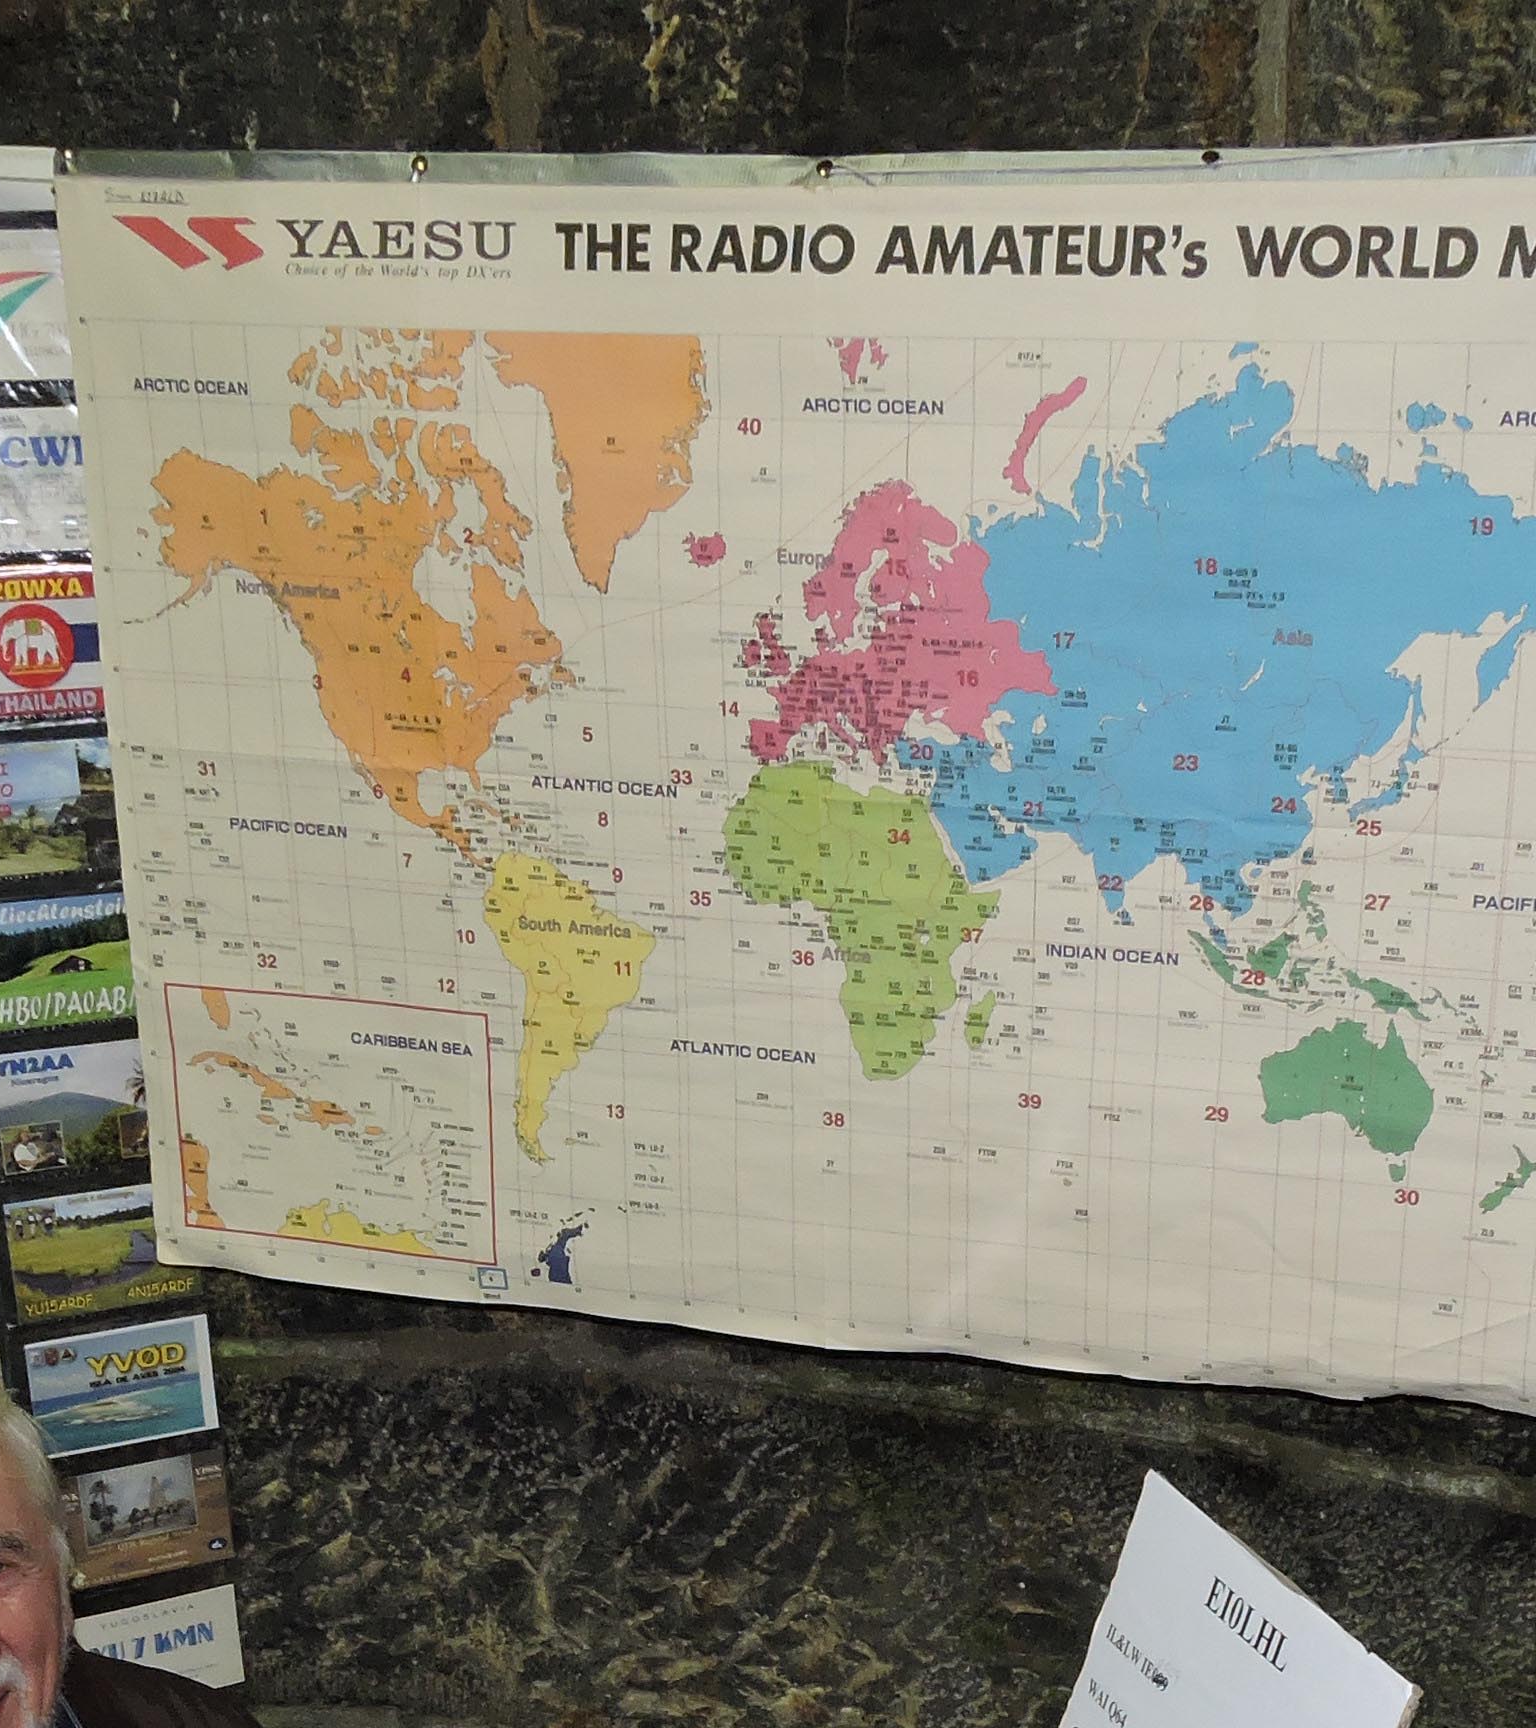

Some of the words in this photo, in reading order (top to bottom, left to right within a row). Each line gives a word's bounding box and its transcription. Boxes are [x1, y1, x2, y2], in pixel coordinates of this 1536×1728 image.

[276, 219, 517, 261] YAESU
[555, 221, 651, 274] THE
[670, 221, 856, 276] RADIO
[874, 224, 1208, 280] AMATEUR's
[1235, 224, 1479, 280] WORLD
[285, 263, 328, 277] Choice
[334, 263, 349, 278] of
[355, 263, 374, 277] the
[381, 263, 429, 277] World's
[438, 266, 459, 281] top
[133, 377, 191, 395] ARCTIC
[195, 378, 249, 397] OCEAN
[802, 397, 869, 416] ARCTIC
[874, 398, 944, 416] OCEAN
[738, 417, 761, 435] 40
[259, 508, 268, 525] 1
[1471, 518, 1493, 535] 19
[464, 528, 474, 545] 2
[777, 548, 834, 571] Europe
[884, 557, 906, 577] 15
[1194, 557, 1216, 575] 18
[235, 578, 276, 597] North
[277, 582, 340, 601] America
[1052, 632, 1076, 650] 17
[1272, 627, 1313, 647] Asia
[312, 674, 323, 691] 3
[400, 667, 412, 684] 4
[956, 669, 979, 687] 16
[720, 702, 739, 717] 14
[582, 727, 592, 743] 5
[911, 743, 933, 759] 20
[197, 761, 217, 778] 31
[1172, 755, 1197, 771] 23
[671, 769, 693, 786] 33
[372, 781, 383, 798] 6
[531, 776, 613, 793] ATLANTIC
[618, 781, 678, 799] OCEAN
[1022, 800, 1044, 817] 21
[1270, 796, 1296, 813] 24
[598, 811, 609, 828] 8
[1357, 819, 1382, 836] 25
[229, 818, 289, 834] PACIFIC
[294, 822, 348, 839] OCEAN
[887, 828, 911, 845] 34
[402, 853, 412, 869] 7
[612, 867, 624, 884] 9
[1098, 876, 1123, 892] 22
[689, 890, 712, 907] 35
[1189, 894, 1215, 912] 26
[1364, 894, 1389, 911] 27
[0, 897, 126, 925] Liechtenstei
[518, 916, 564, 934] South
[568, 921, 632, 939] America
[961, 928, 984, 944] 37
[456, 929, 475, 945] 10
[257, 952, 277, 969] 32
[791, 950, 815, 967] 36
[821, 946, 872, 964] Africa
[1045, 943, 1107, 961] INDIAN
[1113, 948, 1180, 966] OCEAN
[613, 960, 632, 978] 11
[1241, 968, 1266, 986] 28
[437, 977, 455, 994] 12
[351, 1032, 437, 1053] CARIBBEAN
[442, 1041, 473, 1057] SEA
[670, 1039, 752, 1059] ATLANTIC
[756, 1046, 816, 1064] OCEAN
[1018, 1093, 1042, 1109] 39
[606, 1104, 625, 1120] 13
[822, 1111, 845, 1128] 38
[1205, 1106, 1230, 1122] 29
[1394, 1188, 1420, 1206] 30
[154, 1620, 214, 1654] KMN
[1088, 1677, 1109, 1710] WAI
